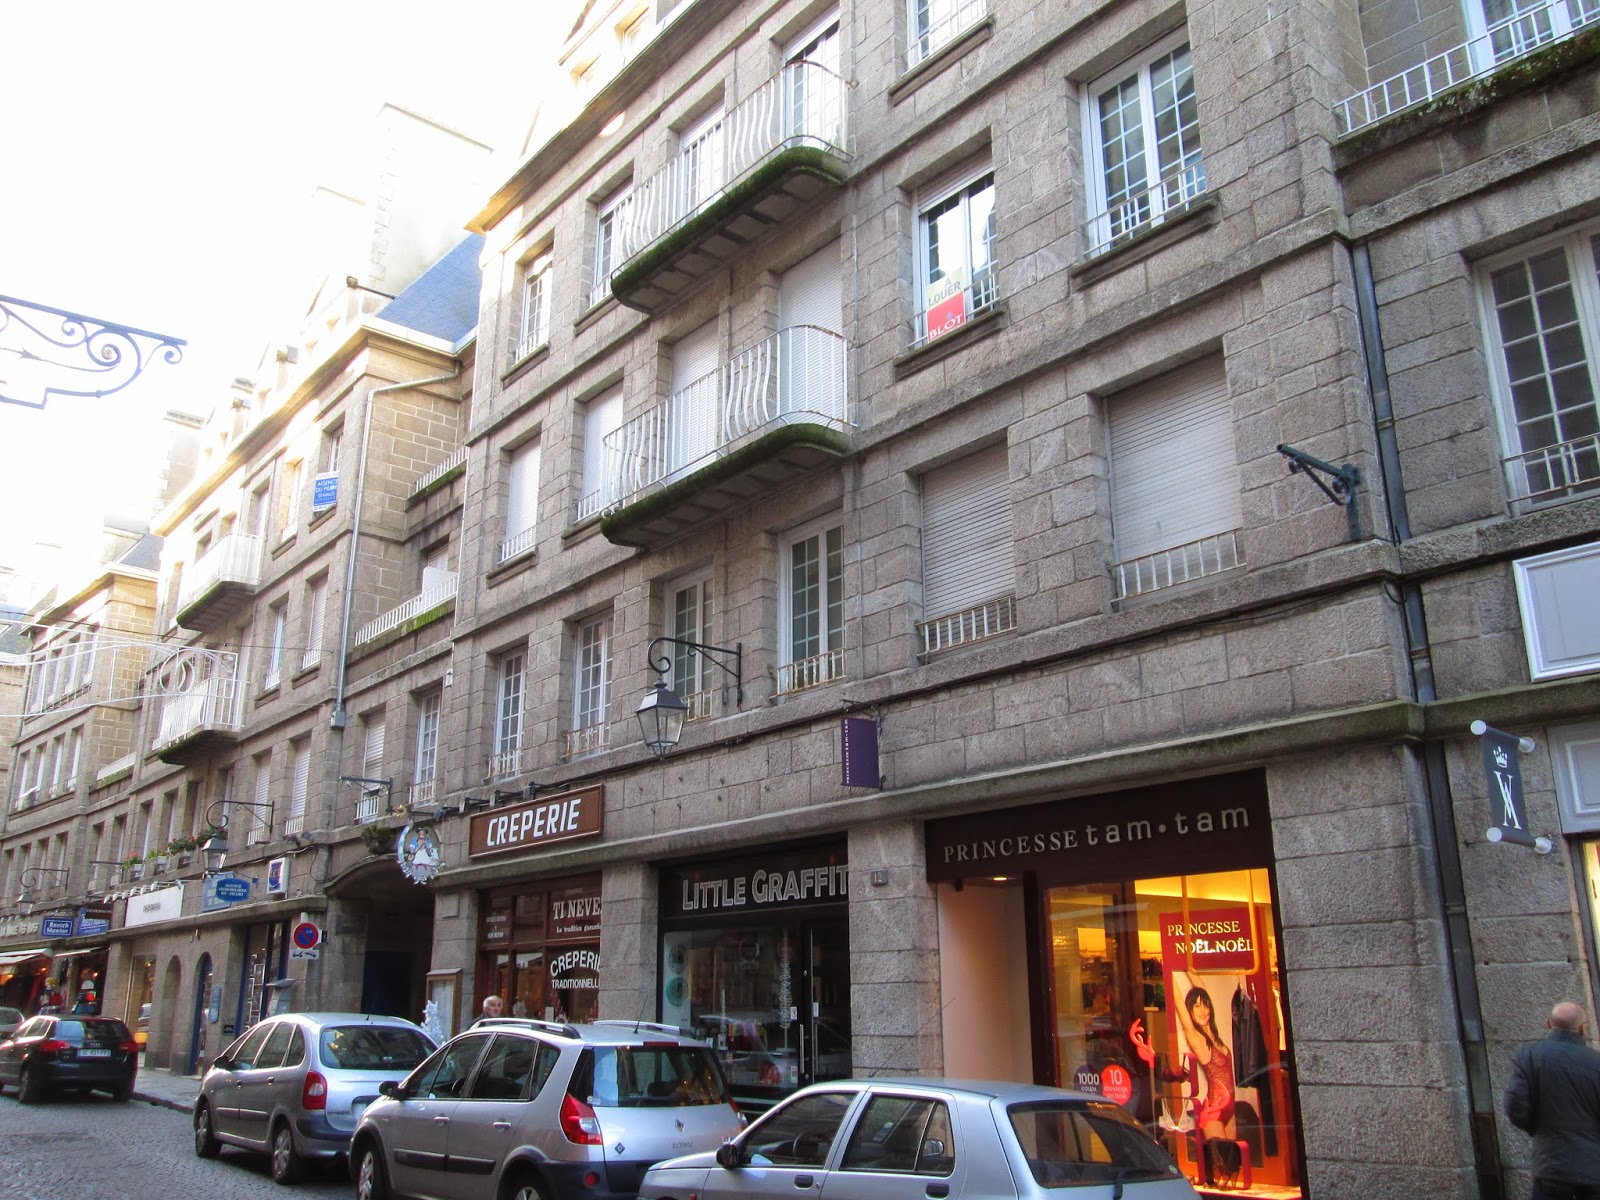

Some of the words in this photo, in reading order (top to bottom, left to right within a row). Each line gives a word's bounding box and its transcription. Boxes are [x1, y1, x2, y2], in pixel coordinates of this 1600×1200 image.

[928, 281, 962, 307] LOUER
[929, 313, 963, 340] BLOT
[486, 798, 582, 847] CREPERIE
[943, 830, 1079, 863] PRINCESSE
[873, 873, 884, 884] 12
[553, 900, 565, 920] TI
[567, 896, 602, 918] NEVE
[564, 924, 582, 932] tradition
[1167, 920, 1241, 936] PRNCESSE
[551, 978, 601, 990] TRADITIONNELL
[1077, 1072, 1100, 1085] 1000
[1109, 1069, 1123, 1085] 10
